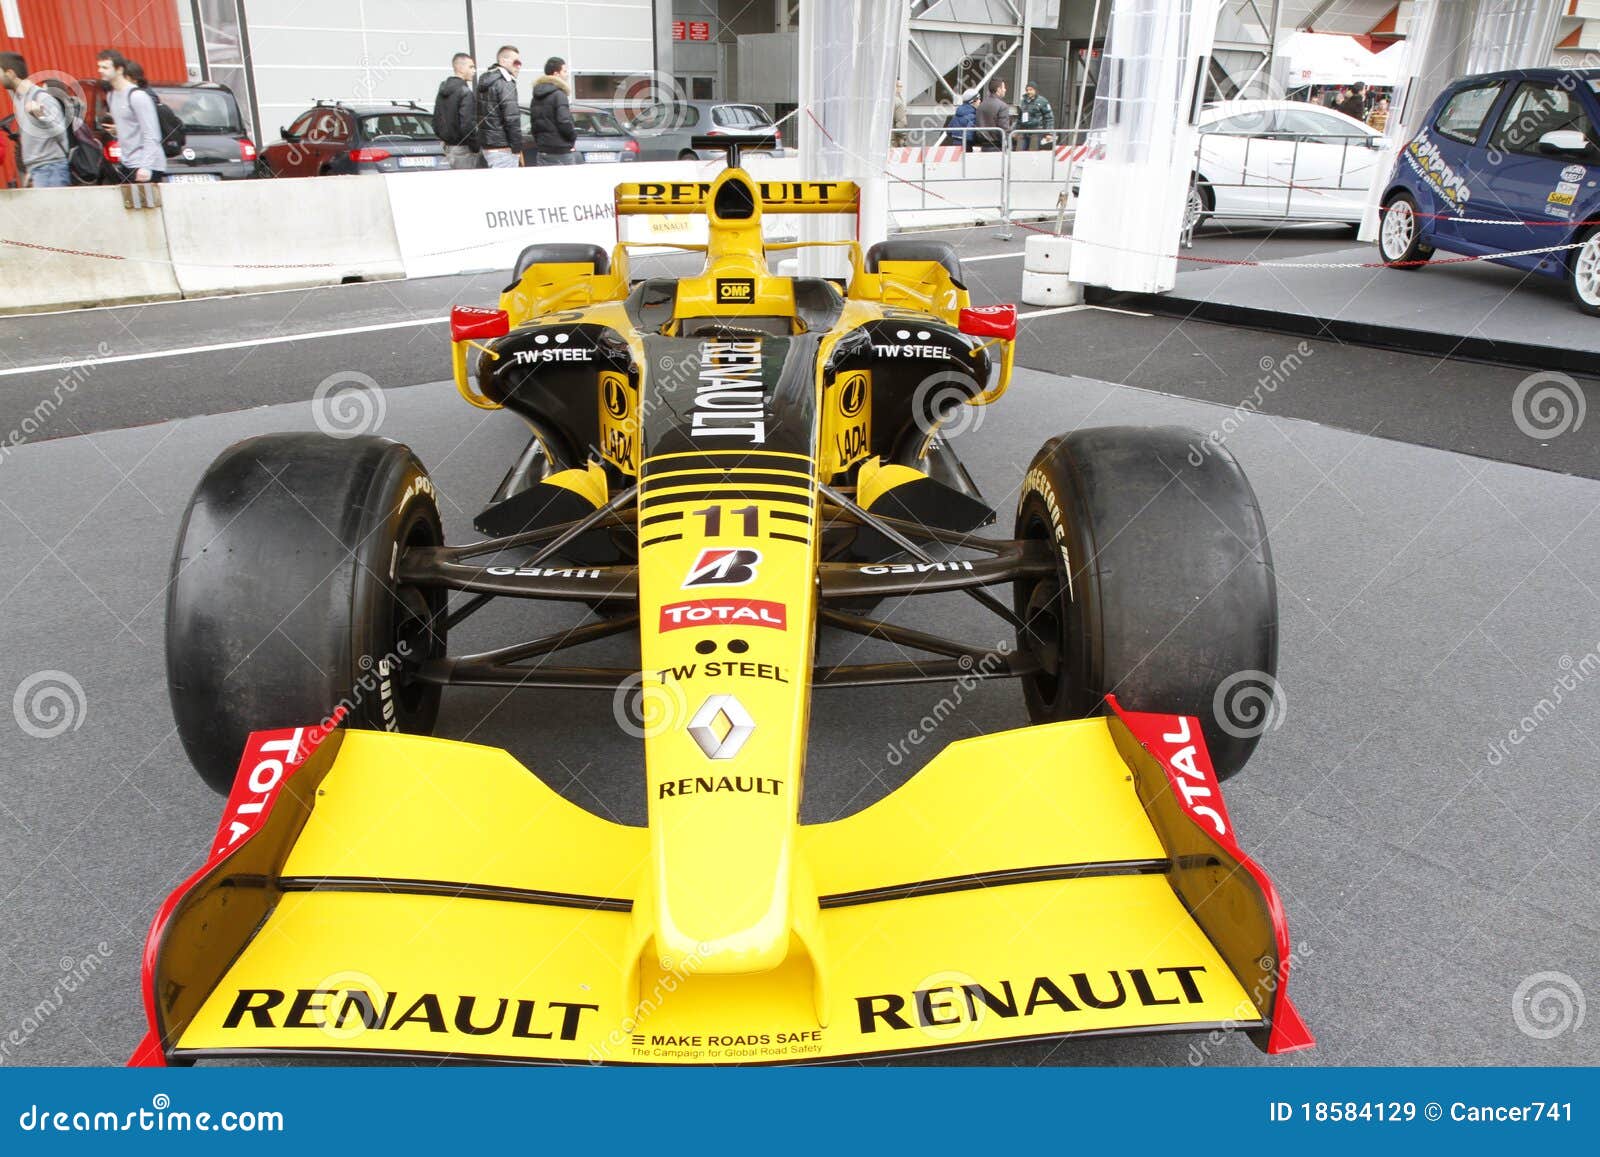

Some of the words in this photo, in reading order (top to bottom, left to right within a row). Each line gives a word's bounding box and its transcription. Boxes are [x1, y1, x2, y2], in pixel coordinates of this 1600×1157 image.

[486, 209, 535, 228] DRIVE
[538, 206, 568, 224] THE
[721, 286, 750, 297] OMP
[454, 305, 499, 315] TOTAL
[513, 352, 542, 364] TW
[543, 349, 592, 361] STEEL
[874, 345, 901, 357] TW
[903, 345, 951, 359] STEEL
[691, 342, 765, 443] RENAULT
[603, 424, 637, 470] LADA
[835, 421, 867, 470] LADA
[692, 505, 759, 537] 11
[664, 606, 782, 624] TOTAL
[656, 664, 697, 685] TW
[704, 662, 789, 684] STEEL
[659, 776, 784, 800] RENAULT
[855, 965, 1207, 1034] RENAULT
[222, 989, 600, 1041] RENAULT
[651, 1035, 701, 1047] MAKE
[708, 1034, 770, 1047] ROADS
[776, 1030, 822, 1044] SAFE
[632, 1048, 651, 1056] The
[653, 1048, 704, 1059] Campaign
[708, 1048, 722, 1057] for
[724, 1047, 757, 1057] Global
[761, 1047, 787, 1056] Road
[790, 1044, 822, 1054] Safety
